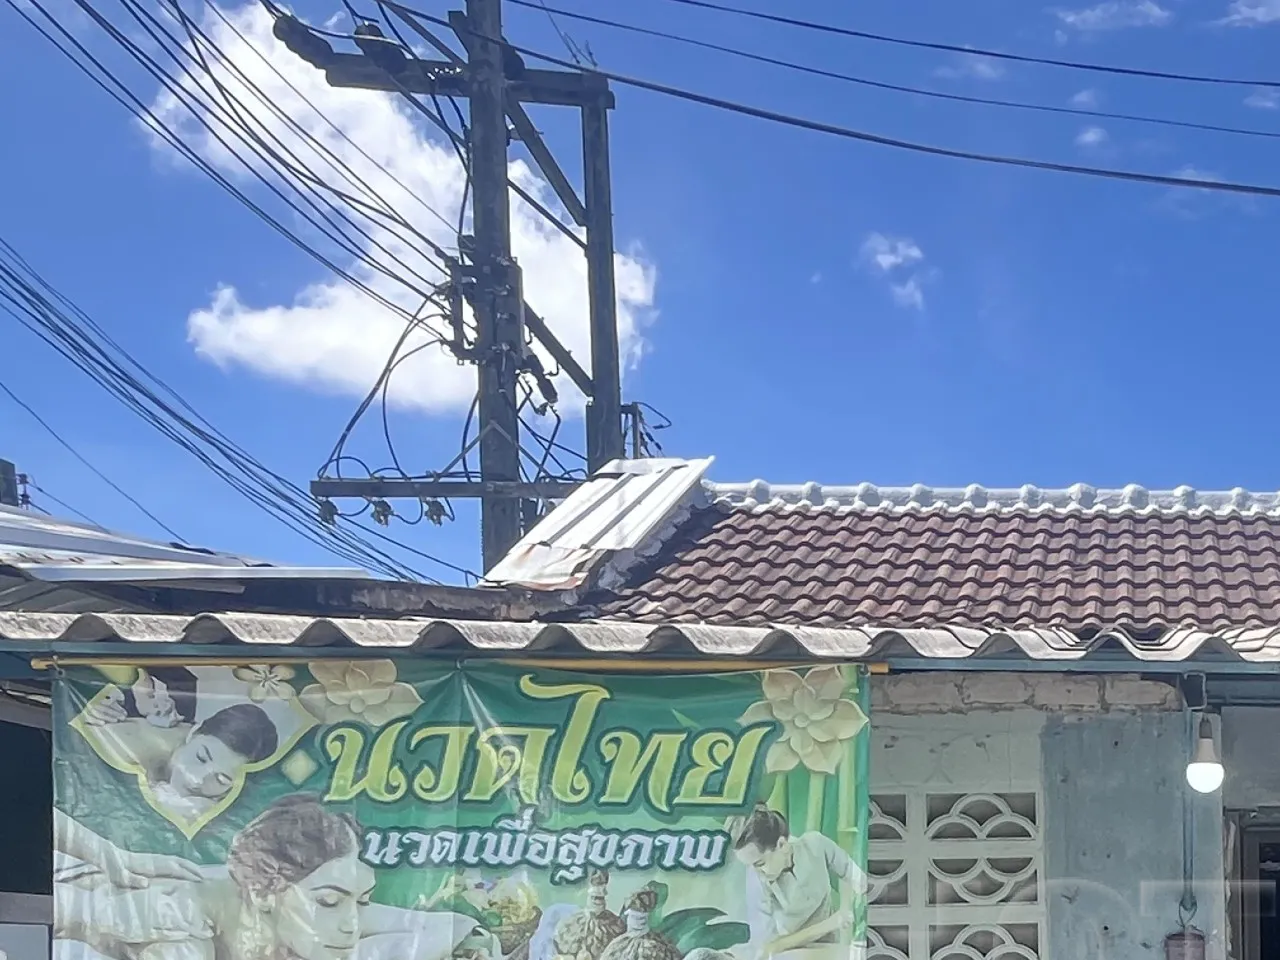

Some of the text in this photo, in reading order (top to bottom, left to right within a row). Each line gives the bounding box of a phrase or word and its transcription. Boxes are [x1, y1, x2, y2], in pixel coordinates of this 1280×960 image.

[322, 674, 779, 806] นวดไทย
[363, 812, 728, 880] นวดเพื่อสุขภาพ
